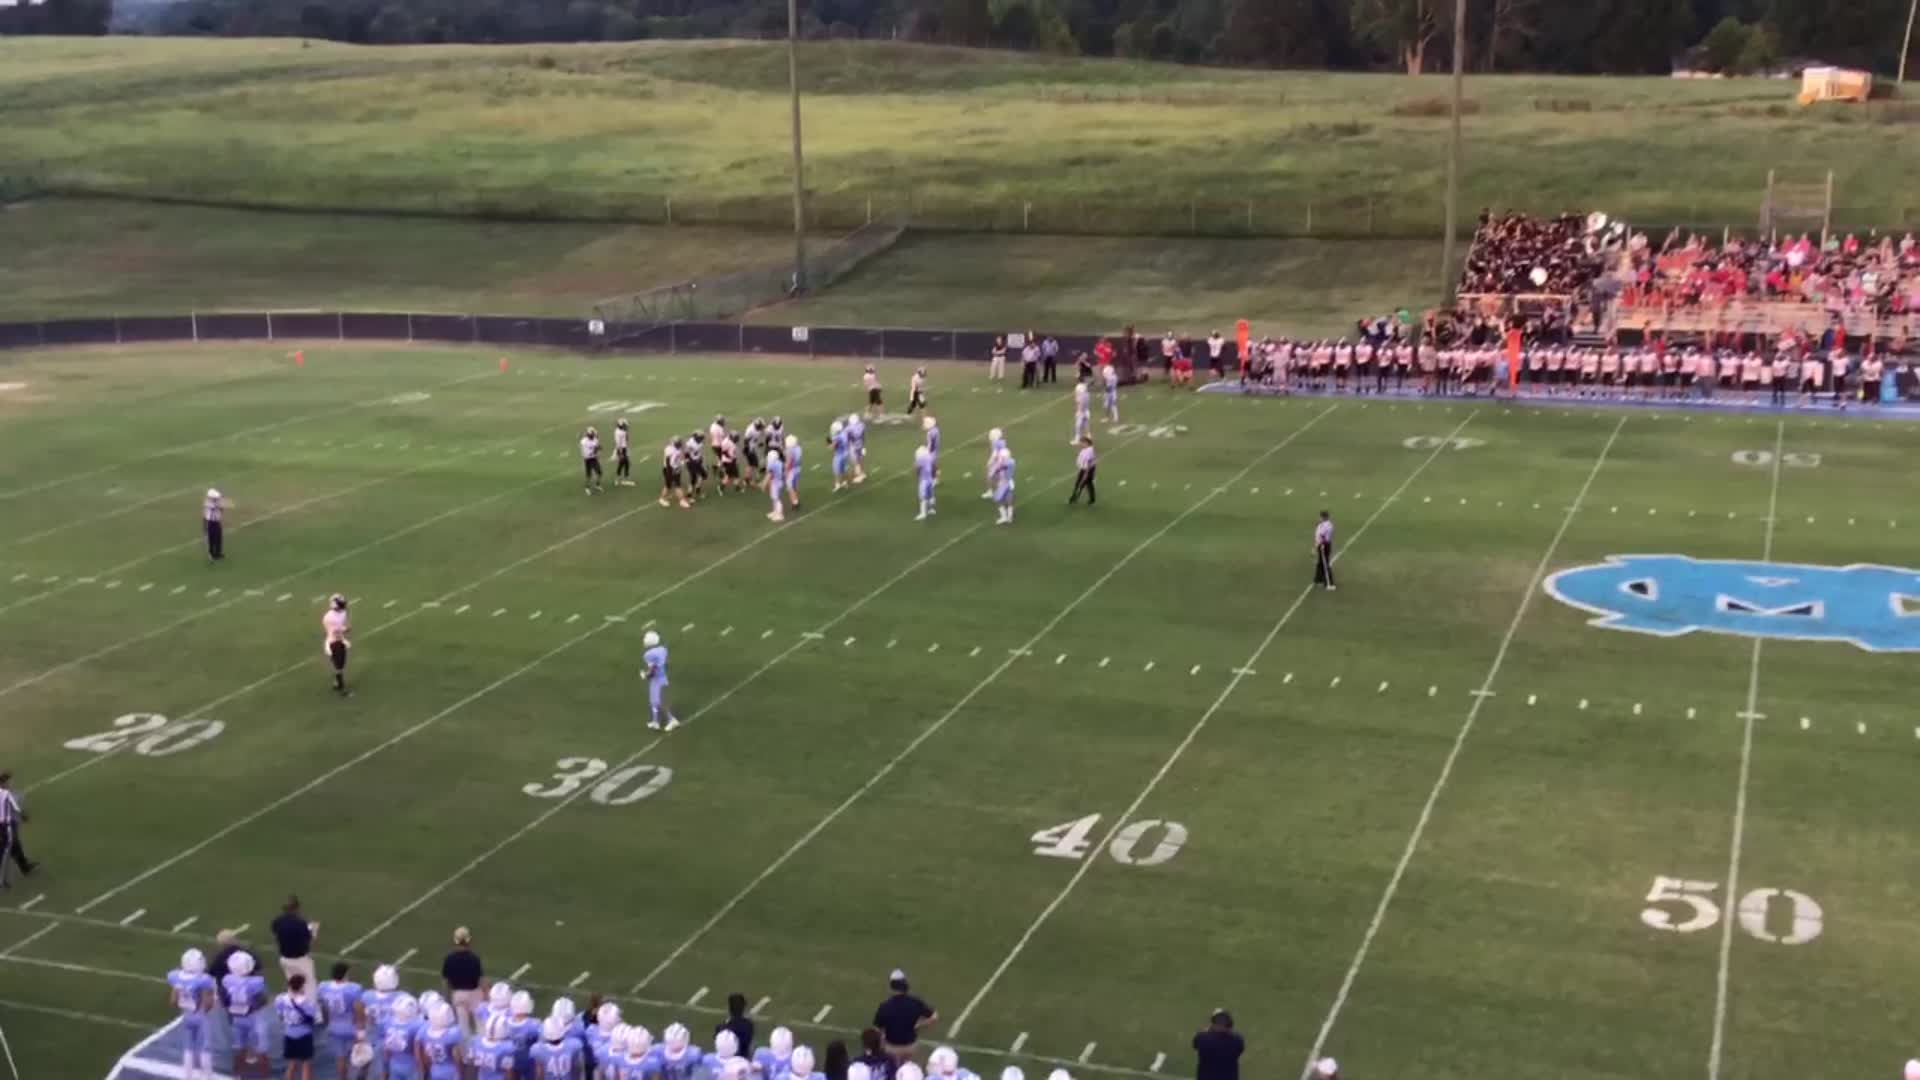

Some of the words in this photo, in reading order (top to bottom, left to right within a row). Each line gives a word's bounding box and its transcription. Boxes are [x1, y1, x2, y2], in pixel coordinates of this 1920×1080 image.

[63, 713, 225, 756] 20
[522, 756, 673, 804] 30
[1031, 813, 1188, 866] 40
[1640, 876, 1823, 945] 50
